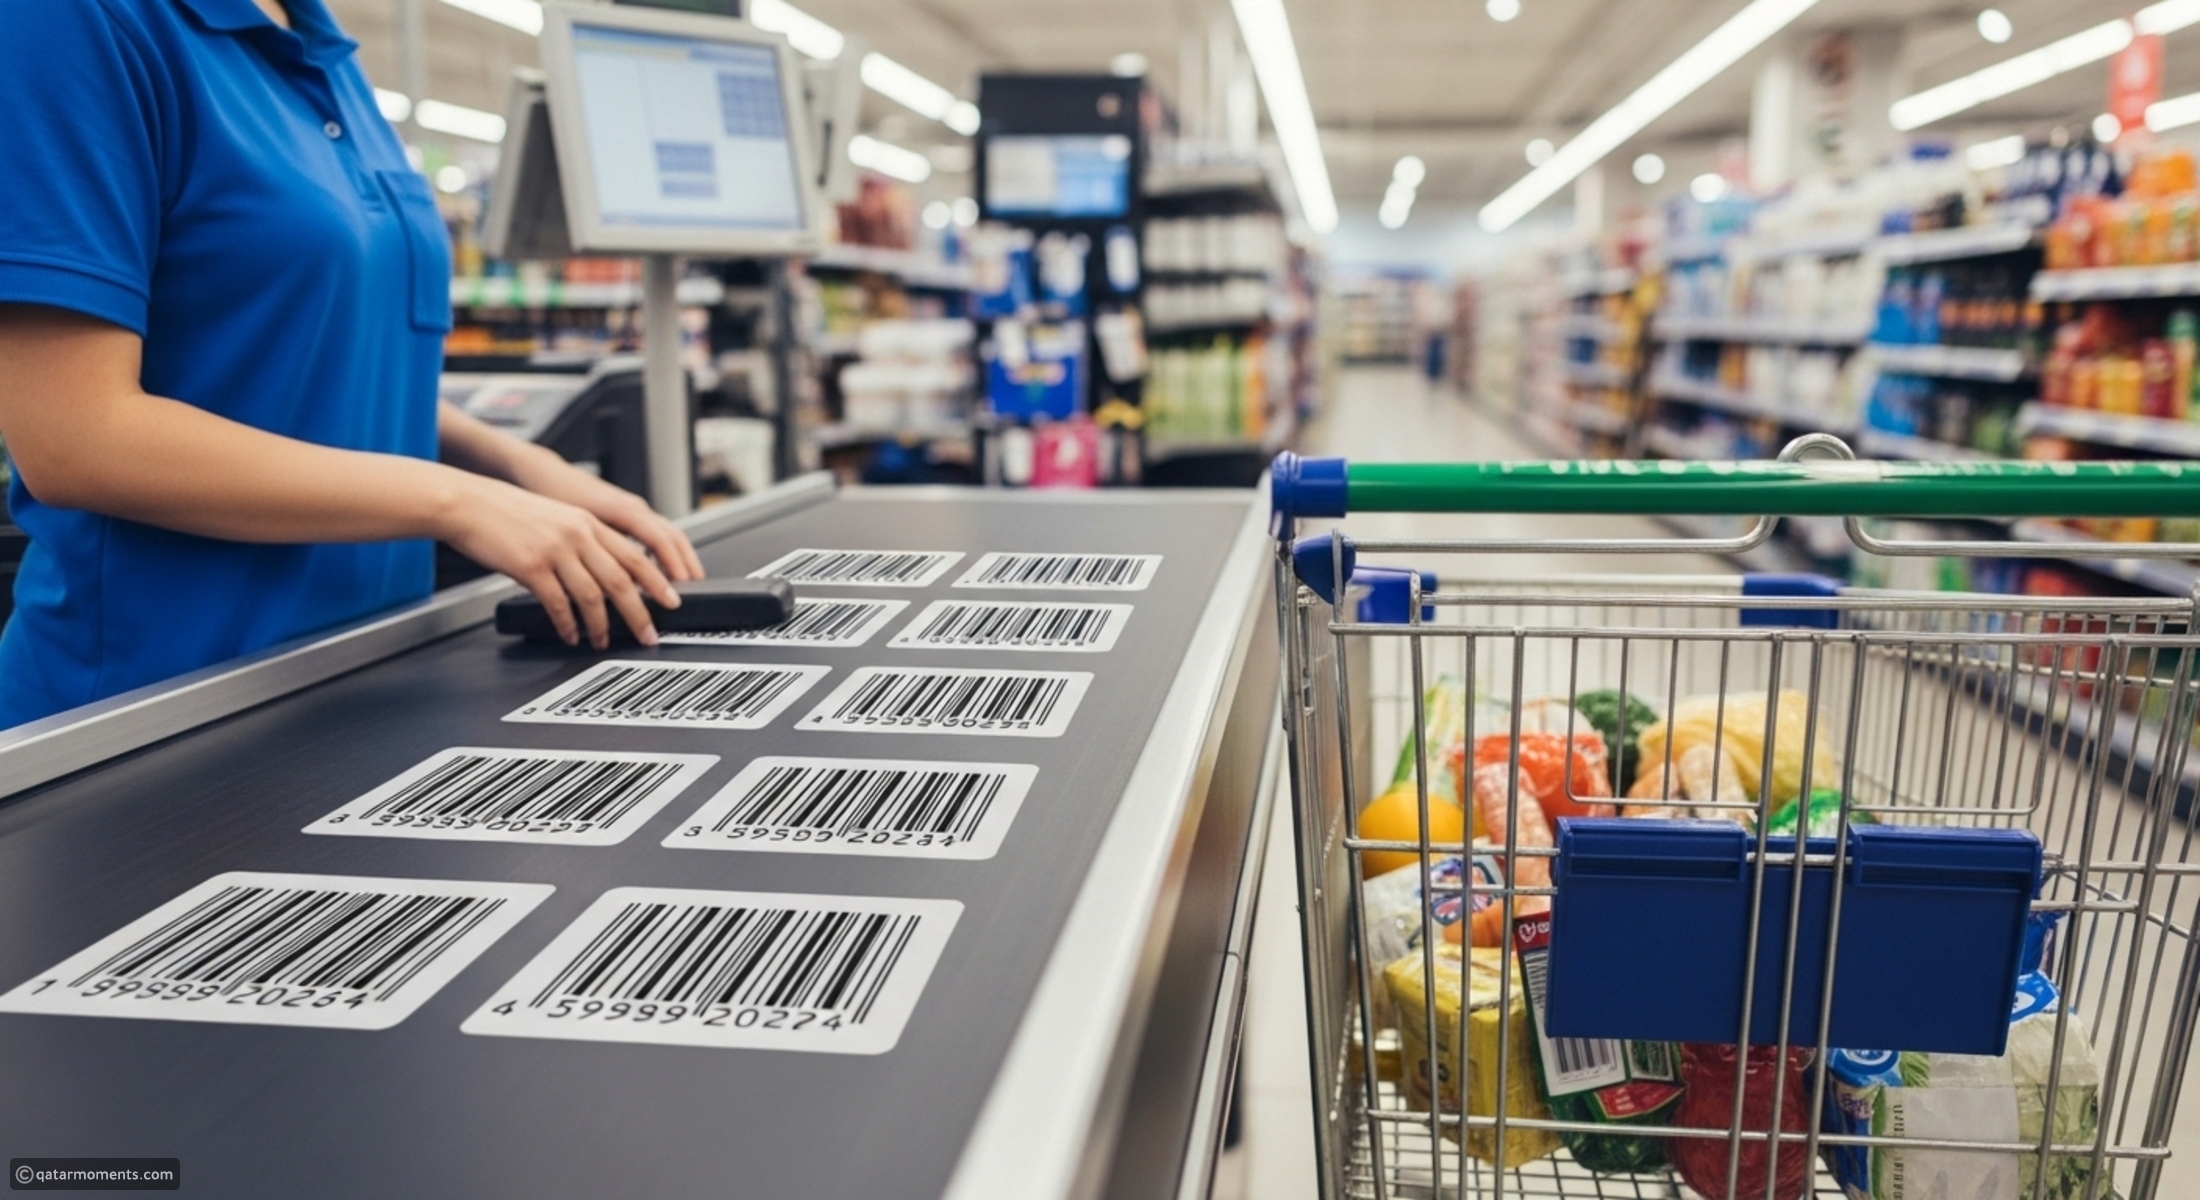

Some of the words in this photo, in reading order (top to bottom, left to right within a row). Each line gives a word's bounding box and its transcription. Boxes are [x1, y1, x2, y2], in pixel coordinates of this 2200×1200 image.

[31, 979, 58, 996] 1
[492, 999, 517, 1016] 4
[547, 999, 687, 1024] 59999
